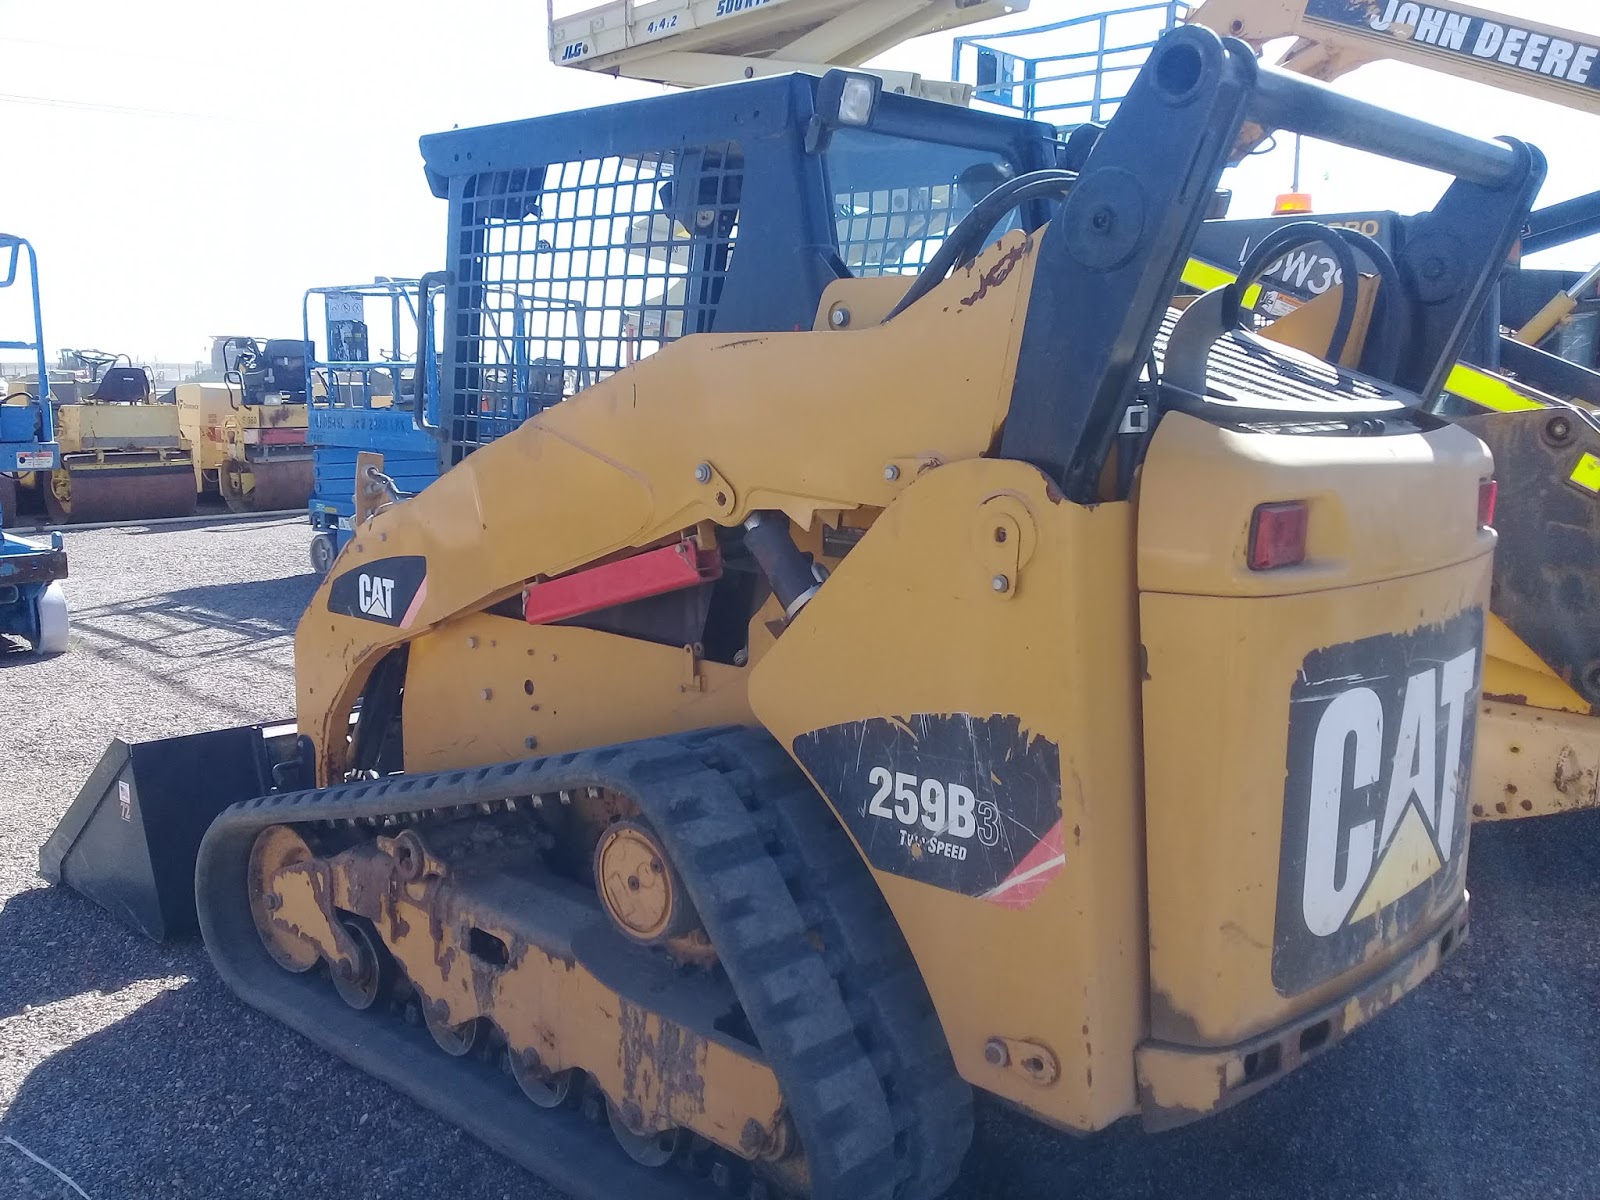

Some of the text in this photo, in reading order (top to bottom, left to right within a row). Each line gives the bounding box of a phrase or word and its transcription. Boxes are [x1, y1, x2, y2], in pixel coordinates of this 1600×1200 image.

[562, 42, 582, 60] JLG
[1369, 0, 1599, 84] JOHN DEERE
[358, 573, 395, 619] CAT
[1302, 647, 1476, 937] CAT
[927, 836, 967, 861] SPEED
